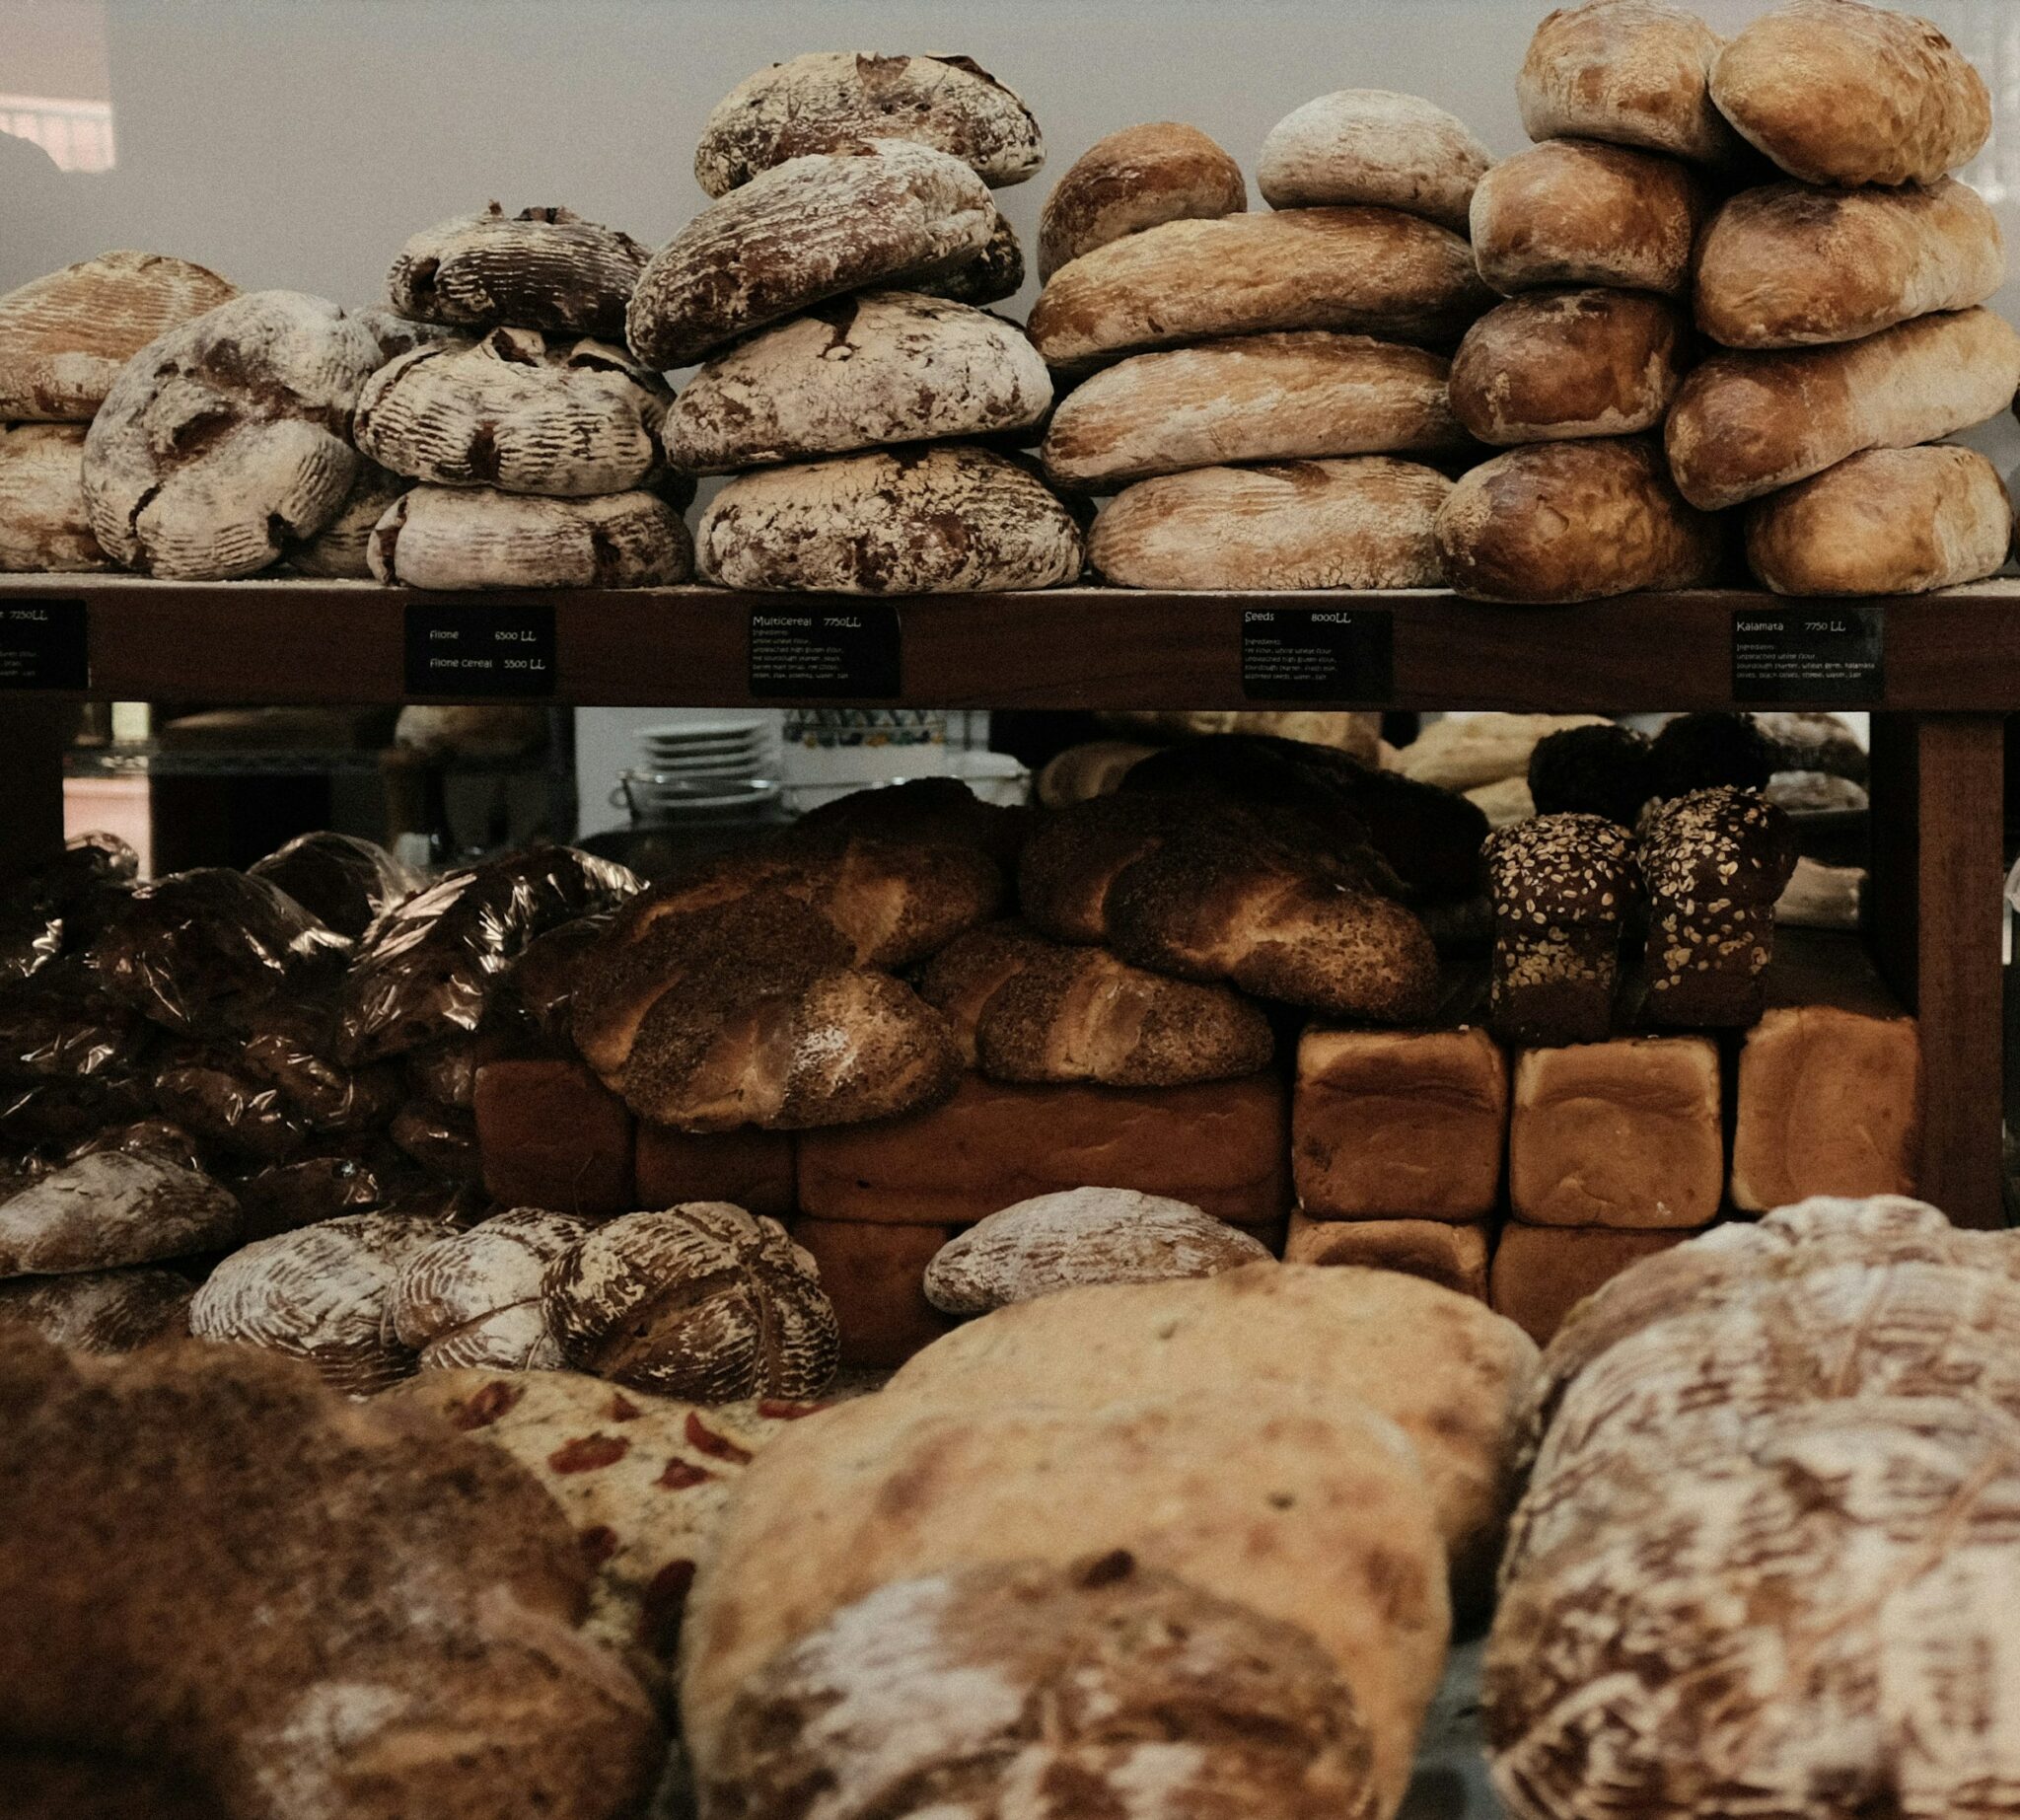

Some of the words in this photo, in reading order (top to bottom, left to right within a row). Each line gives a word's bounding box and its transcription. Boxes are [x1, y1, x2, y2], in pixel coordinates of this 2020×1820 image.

[753, 616, 812, 626] Multicereal
[1245, 612, 1274, 622] Seeds
[1737, 621, 1784, 631] Kalamata
[1805, 621, 1828, 631] 7750
[1830, 620, 1846, 631] LL
[494, 630, 518, 640] 6500
[521, 630, 537, 642] LL
[530, 659, 546, 670] LL
